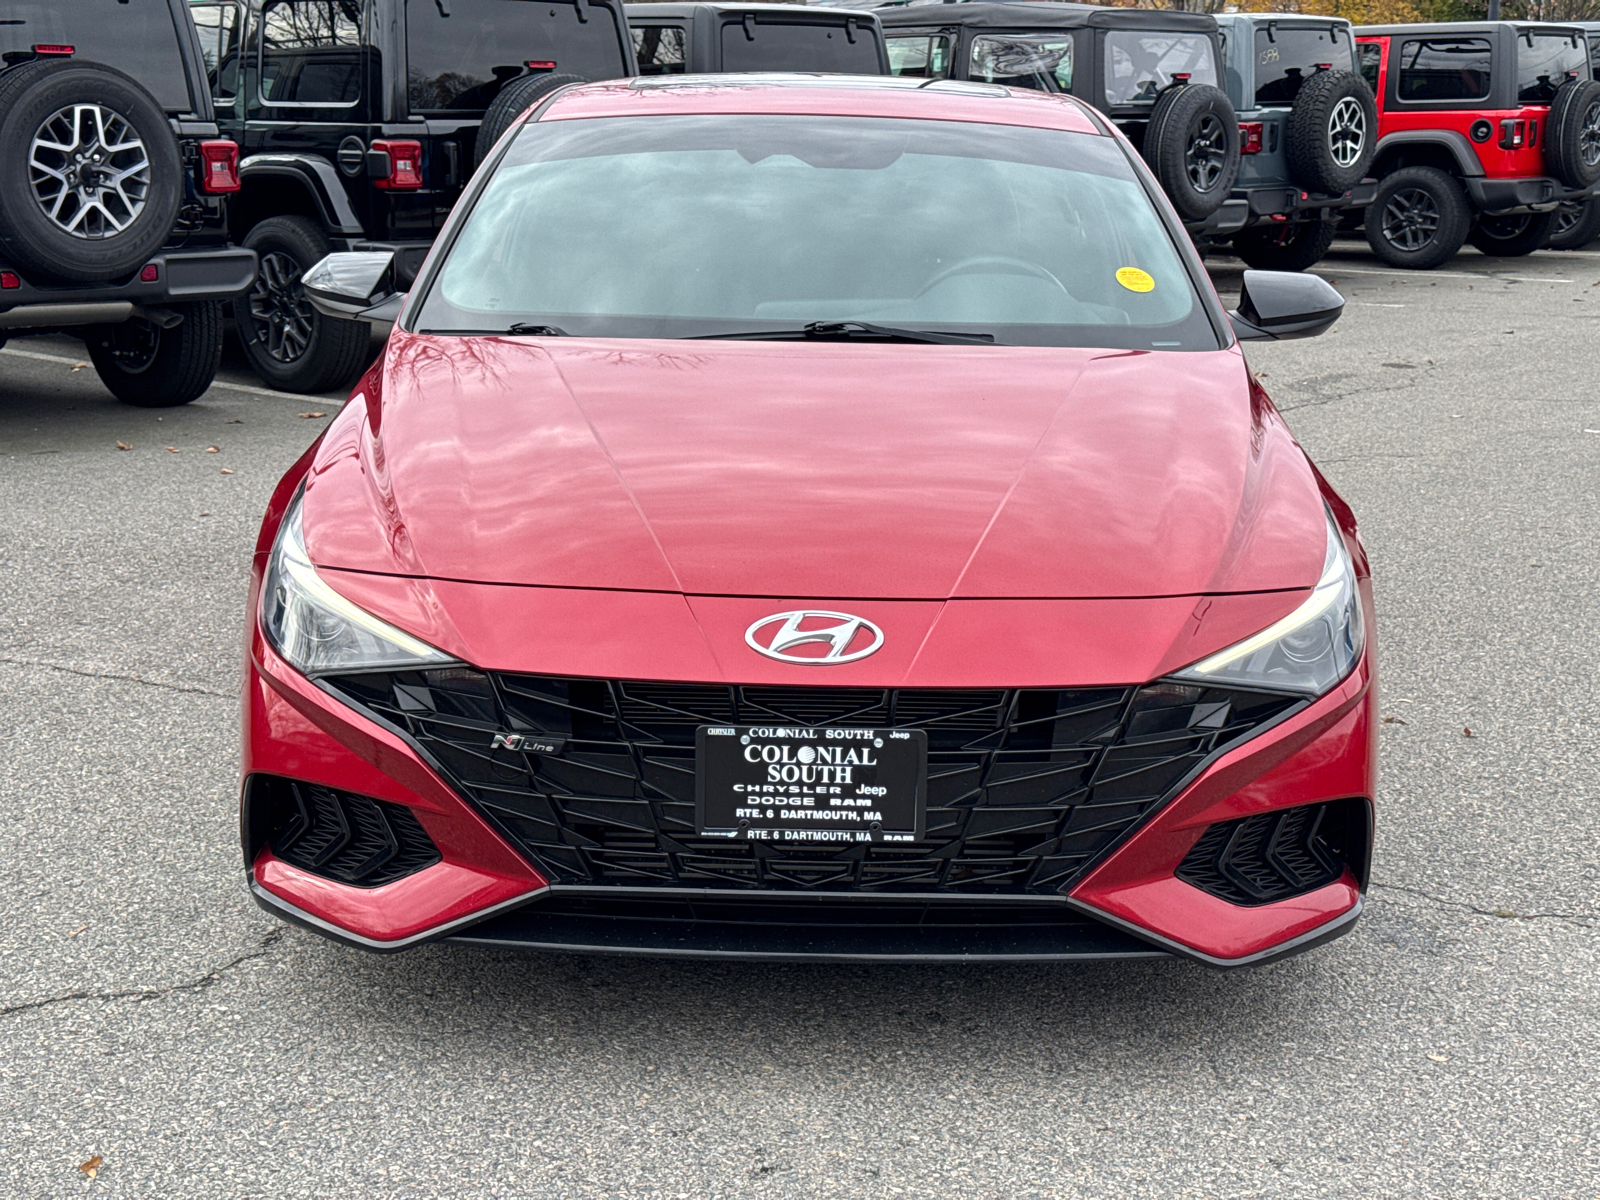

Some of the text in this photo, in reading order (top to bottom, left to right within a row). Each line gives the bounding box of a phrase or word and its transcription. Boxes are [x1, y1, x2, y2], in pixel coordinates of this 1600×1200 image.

[707, 728, 736, 736] CHRYSLER
[749, 727, 875, 740] COLONIAL SOUTH
[889, 731, 911, 740] Jeep
[523, 742, 555, 752] Line
[744, 744, 878, 766] COLONIAL
[767, 764, 854, 784] SOUTH
[733, 783, 887, 797] CHRYSLER Jeep
[747, 796, 872, 807] DODGE RAM
[735, 808, 882, 822] RTE. 6 DARTMOUTH, MA
[747, 830, 872, 842] RTE. 6 DARTMOUTH, MA
[883, 834, 915, 842] RAM
